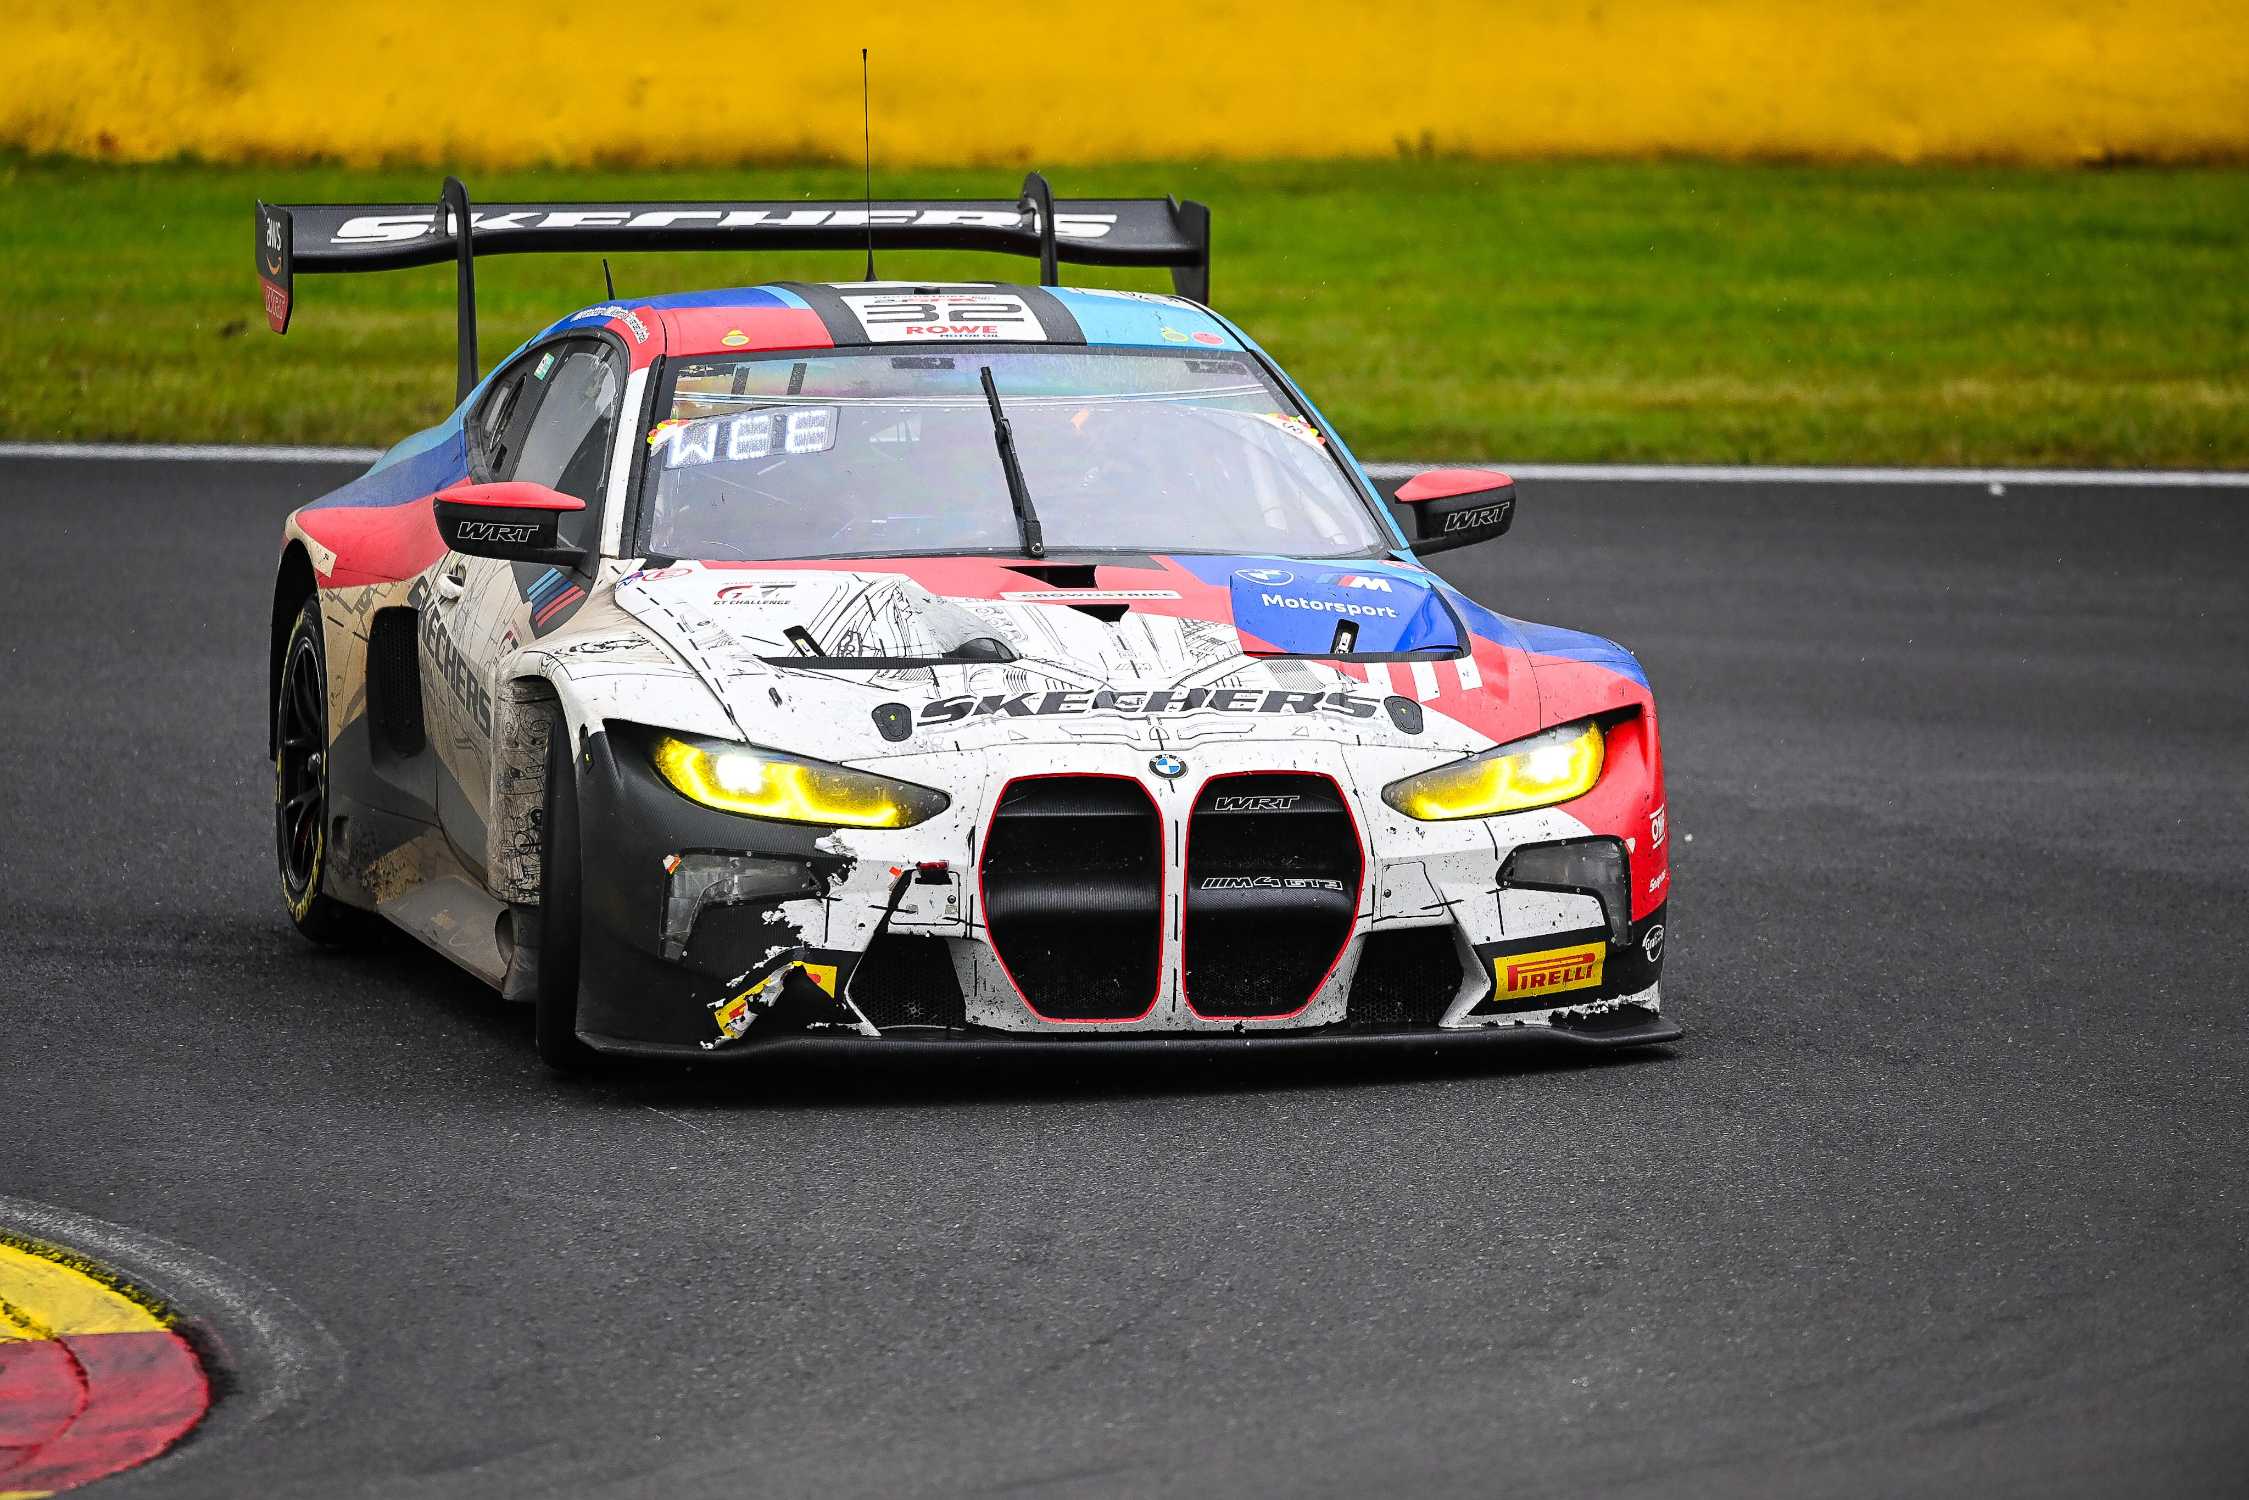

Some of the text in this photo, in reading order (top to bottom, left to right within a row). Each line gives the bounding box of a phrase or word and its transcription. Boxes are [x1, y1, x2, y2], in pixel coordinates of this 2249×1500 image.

[266, 217, 281, 251] aws
[331, 210, 1117, 243] SKECHERS
[864, 303, 1024, 324] 32
[906, 326, 998, 335] ROWE
[1445, 502, 1510, 532] WRT
[457, 521, 540, 542] WRT
[1261, 593, 1399, 618] Motorsport
[917, 687, 1378, 727] SKECHERS
[1214, 796, 1301, 811] WRT
[1283, 878, 1344, 891] GT3
[1507, 952, 1596, 992] PIRELLI
